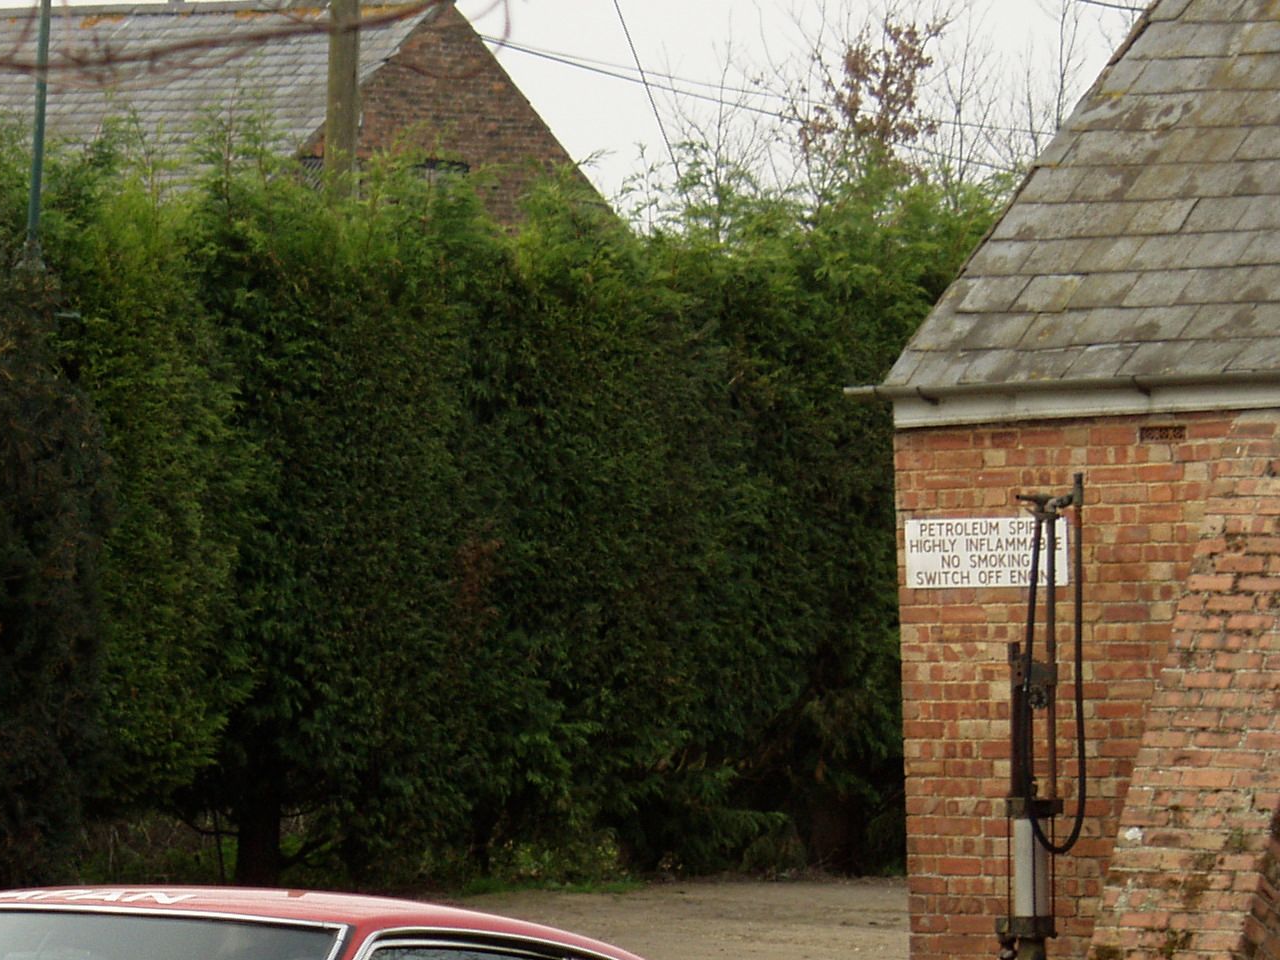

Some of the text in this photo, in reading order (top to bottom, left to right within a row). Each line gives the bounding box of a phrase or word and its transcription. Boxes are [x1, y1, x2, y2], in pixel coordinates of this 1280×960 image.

[919, 520, 1051, 537] PETROLEUM SPIR
[909, 536, 1062, 553] HIGHLY INFLAMMABE
[941, 553, 1030, 569] NO SMOKING
[916, 570, 970, 586] SWITCH
[978, 570, 1002, 585] OFF
